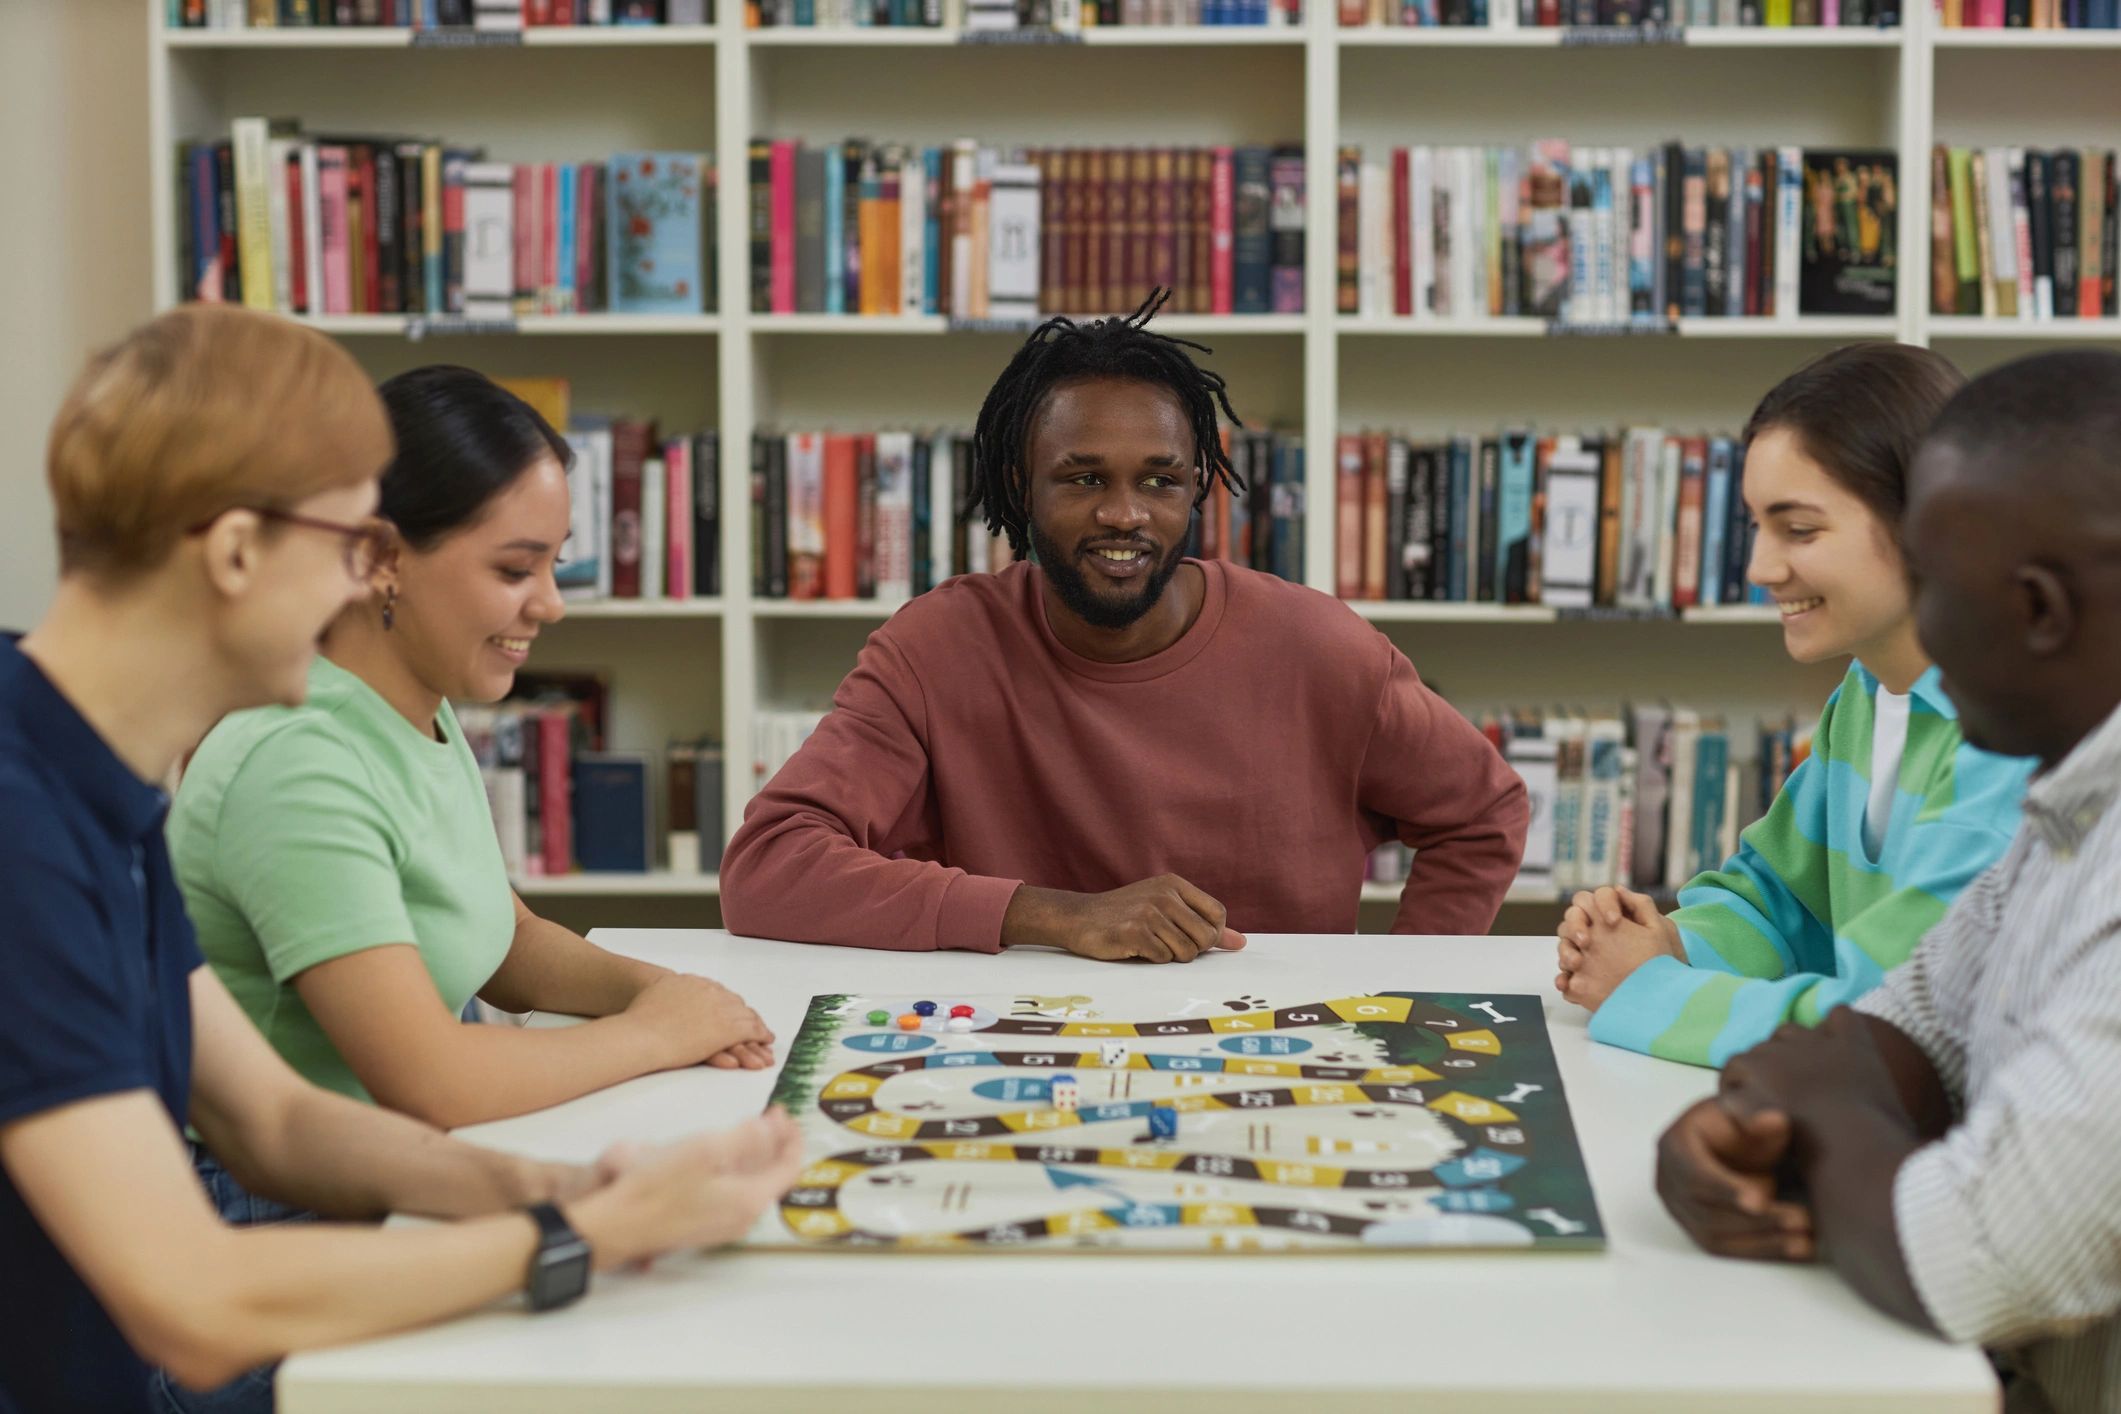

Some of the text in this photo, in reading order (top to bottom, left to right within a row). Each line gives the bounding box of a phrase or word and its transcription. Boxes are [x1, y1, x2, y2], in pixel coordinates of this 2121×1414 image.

[1356, 1005, 1388, 1015] 6
[1288, 1013, 1319, 1022] 5
[1224, 1019, 1254, 1029] 4
[1081, 1027, 1111, 1035] 2
[1157, 1025, 1189, 1034] 3
[1443, 1059, 1476, 1068] 9
